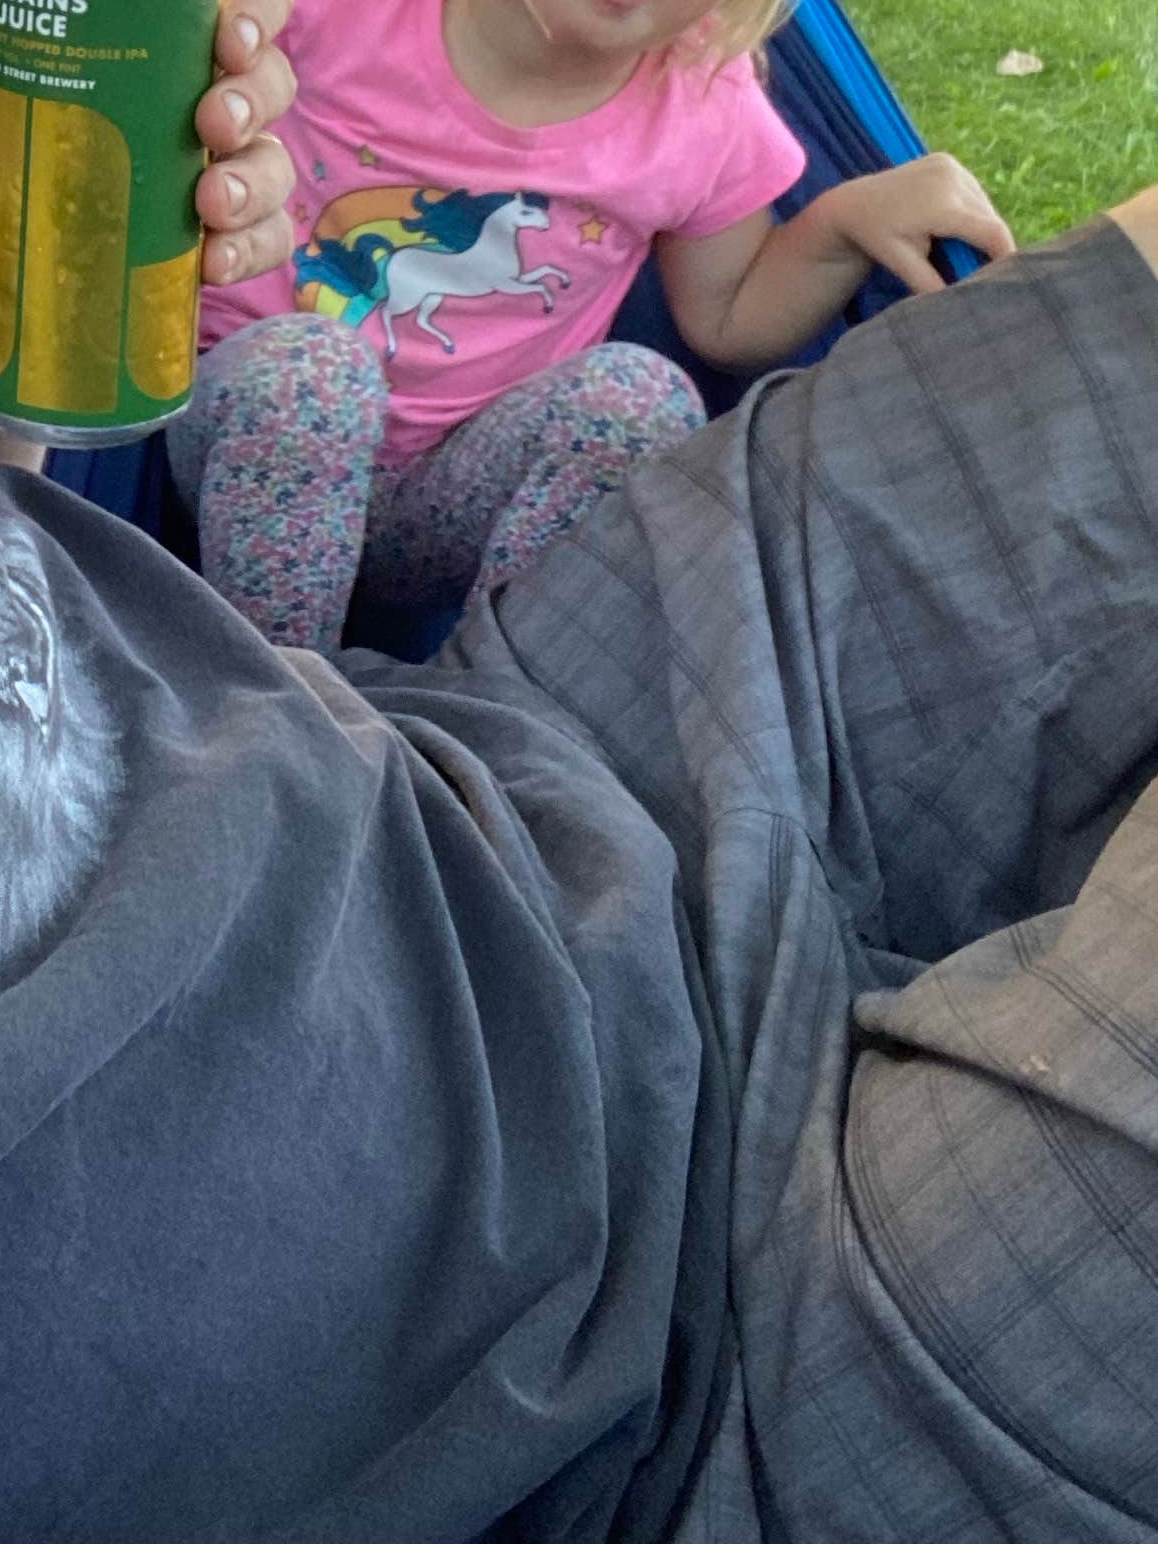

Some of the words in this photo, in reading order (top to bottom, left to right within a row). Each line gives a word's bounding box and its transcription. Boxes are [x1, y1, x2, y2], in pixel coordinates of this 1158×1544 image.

[11, 36, 61, 57] HOPPED
[65, 45, 122, 60] DOUBLE
[125, 48, 149, 60] IPA
[3, 65, 37, 83] STREET
[39, 74, 97, 91] BREWERY
